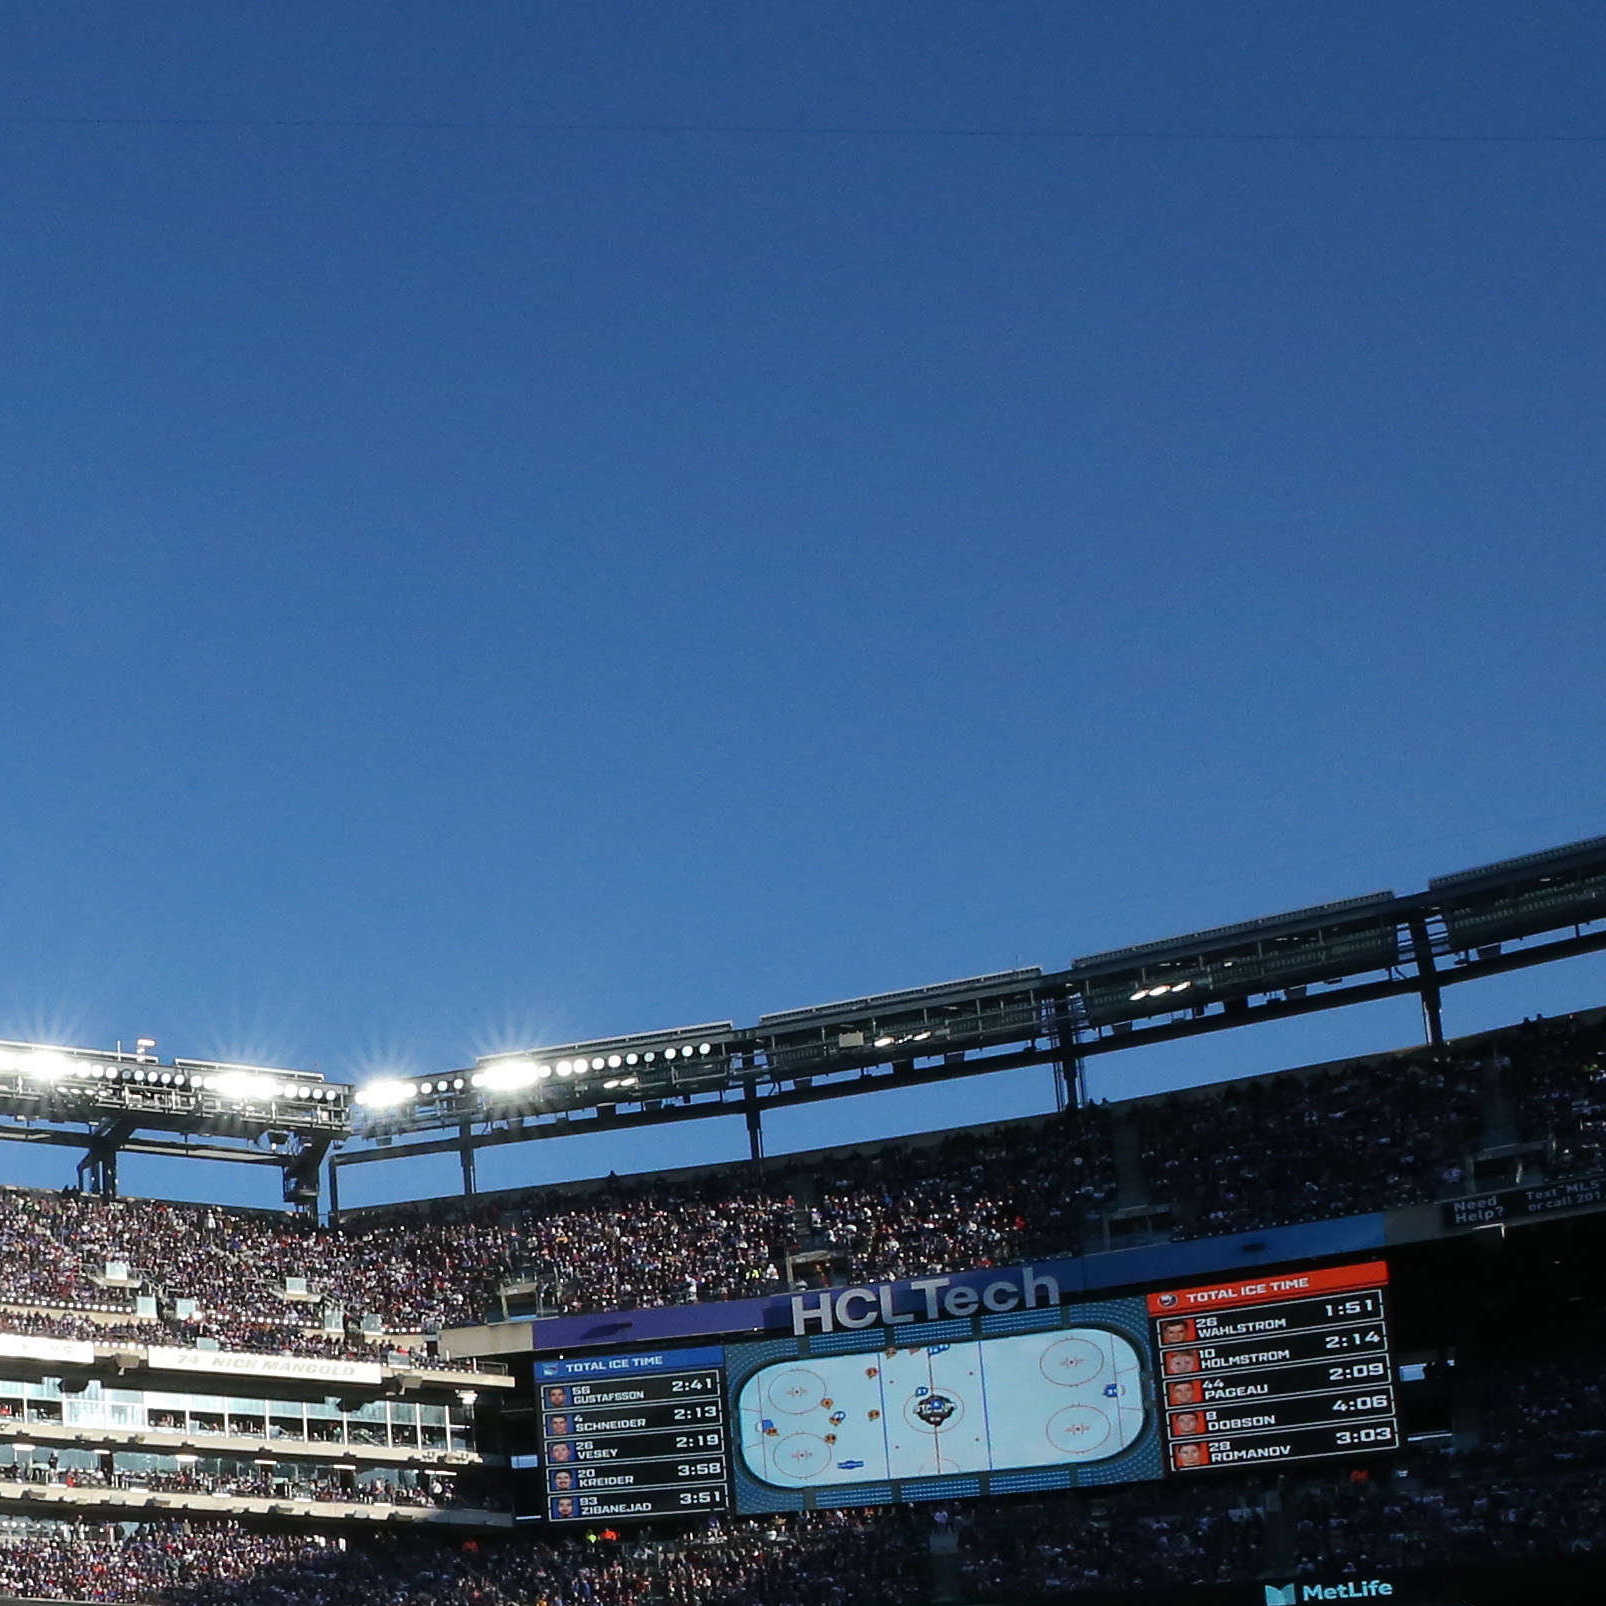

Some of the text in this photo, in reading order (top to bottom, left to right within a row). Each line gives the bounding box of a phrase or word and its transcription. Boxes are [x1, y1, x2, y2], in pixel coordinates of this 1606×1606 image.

[1526, 1188, 1557, 1200] Text
[1453, 1195, 1497, 1212] Need
[1528, 1202, 1543, 1211] or
[1546, 1196, 1571, 1208] call
[1455, 1206, 1505, 1224] Help?
[1186, 1289, 1237, 1303] TOTAL
[1241, 1284, 1267, 1296] ICE
[1270, 1277, 1309, 1290] TIME
[791, 1267, 1060, 1336] HCLTech
[1196, 1299, 1374, 1328] 26 1:51
[1197, 1318, 1287, 1339] WAHLSTROM
[1199, 1331, 1380, 1359] 10 2:14
[176, 1354, 355, 1377] 74 NICK MANGOLD
[566, 1356, 663, 1373] TOTAL ICE TIME
[1201, 1350, 1290, 1369] HOLMSTROM
[1202, 1362, 1384, 1389] 44 2:09
[672, 1378, 712, 1392] 2:41
[1204, 1384, 1269, 1400] PAGEAU
[574, 1391, 645, 1405] GUSTAFSSON
[574, 1406, 717, 1422] 4 2:13
[1206, 1395, 1388, 1421] 8 4:06
[575, 1418, 646, 1432] SCHNEIDER
[1208, 1415, 1276, 1431] DOBSON
[676, 1434, 719, 1448] 2:19
[1209, 1427, 1392, 1452] 28 3:03
[577, 1449, 618, 1459] VESEY
[1211, 1445, 1291, 1463] ROMANOV
[577, 1462, 721, 1478] 20 3:58
[579, 1476, 634, 1487] KREIDER
[679, 1491, 720, 1505] 3:51
[581, 1502, 652, 1515] ZIBANEJAD
[1302, 1580, 1393, 1602] MetLife
